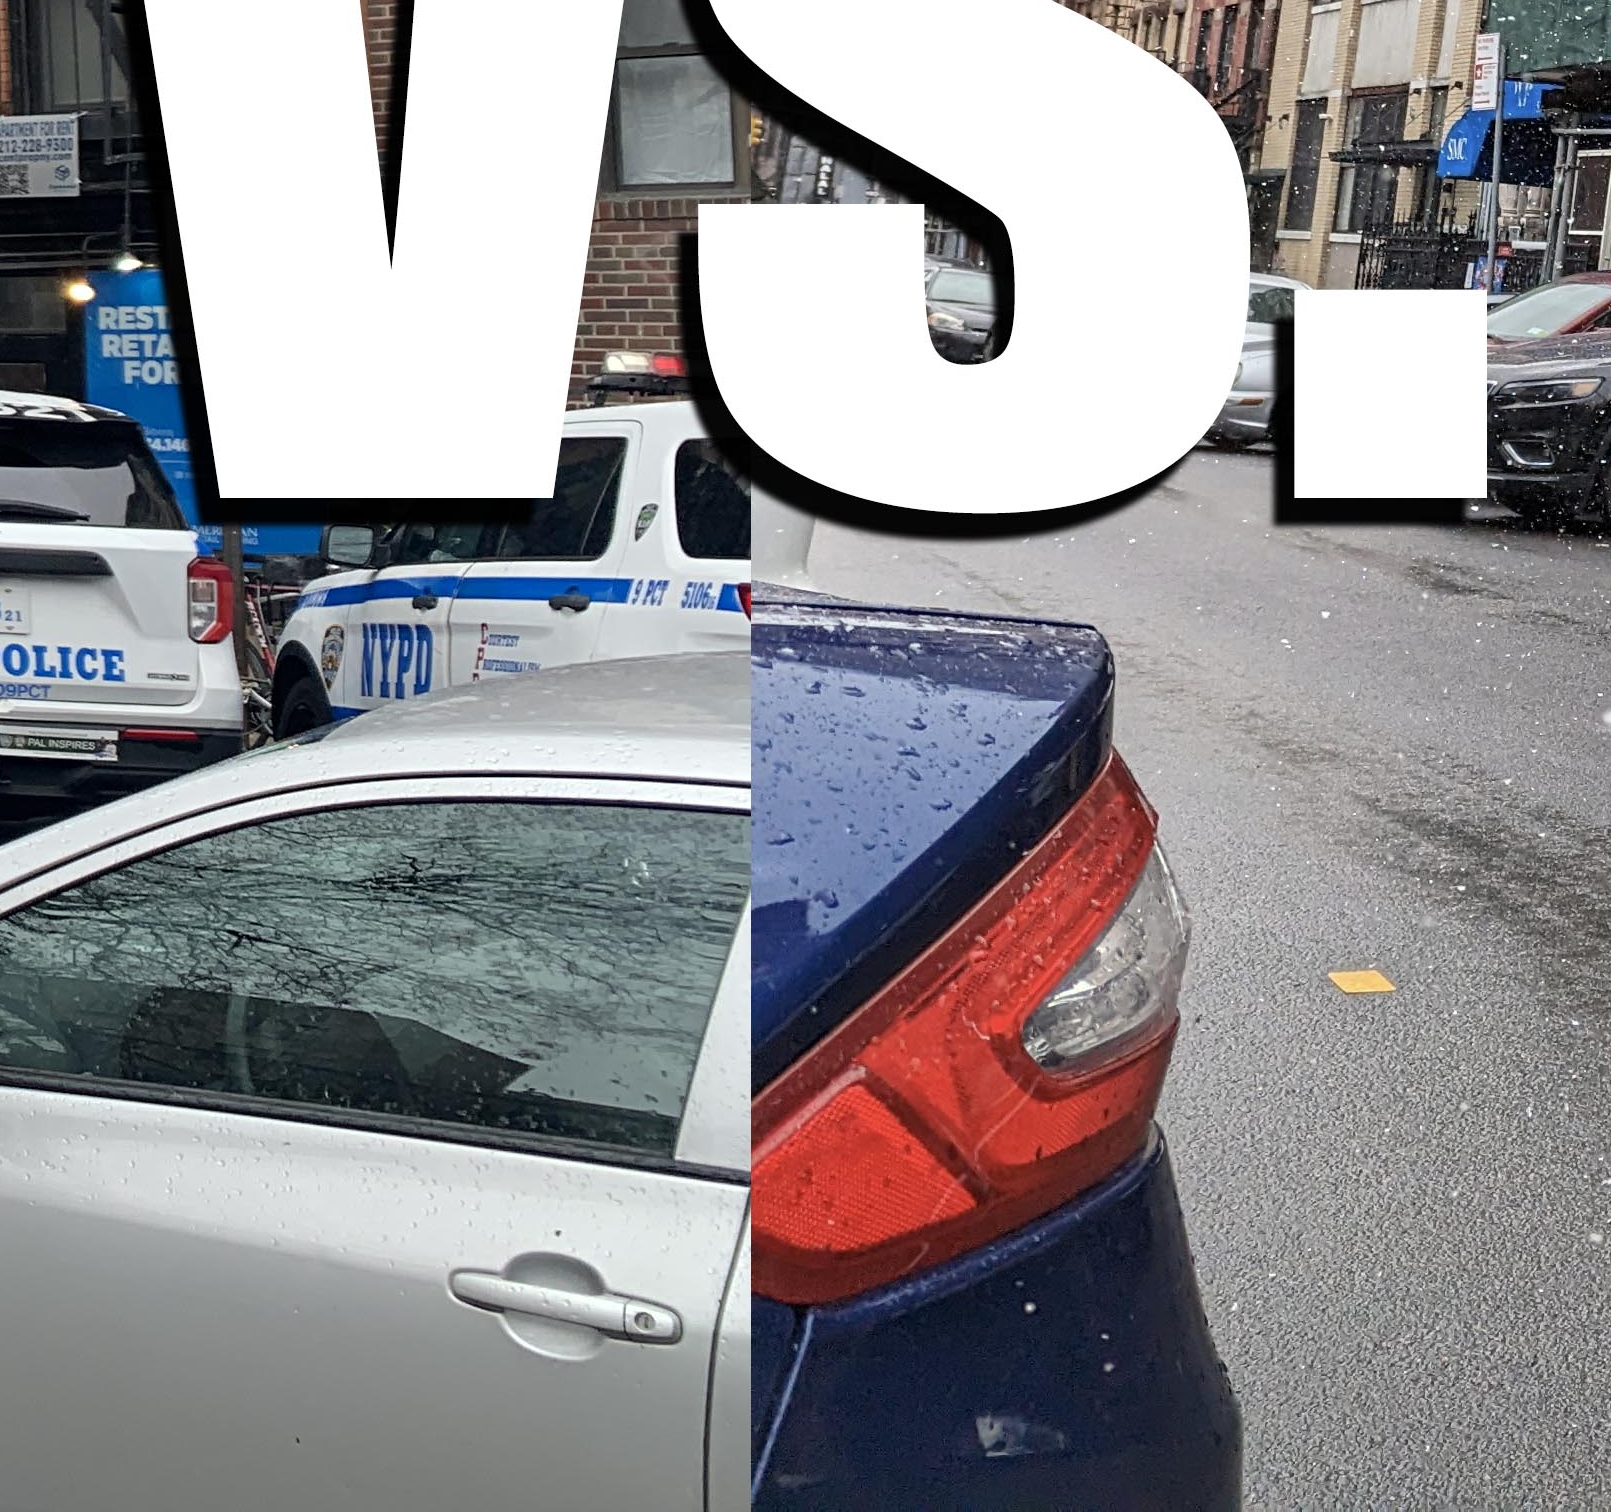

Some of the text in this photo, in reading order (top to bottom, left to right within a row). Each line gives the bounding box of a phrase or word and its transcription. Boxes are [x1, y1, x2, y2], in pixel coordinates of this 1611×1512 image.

[642, 579, 670, 607] PCT
[360, 622, 434, 700] NYPD
[27, 738, 96, 752] PAL INSPIRES
